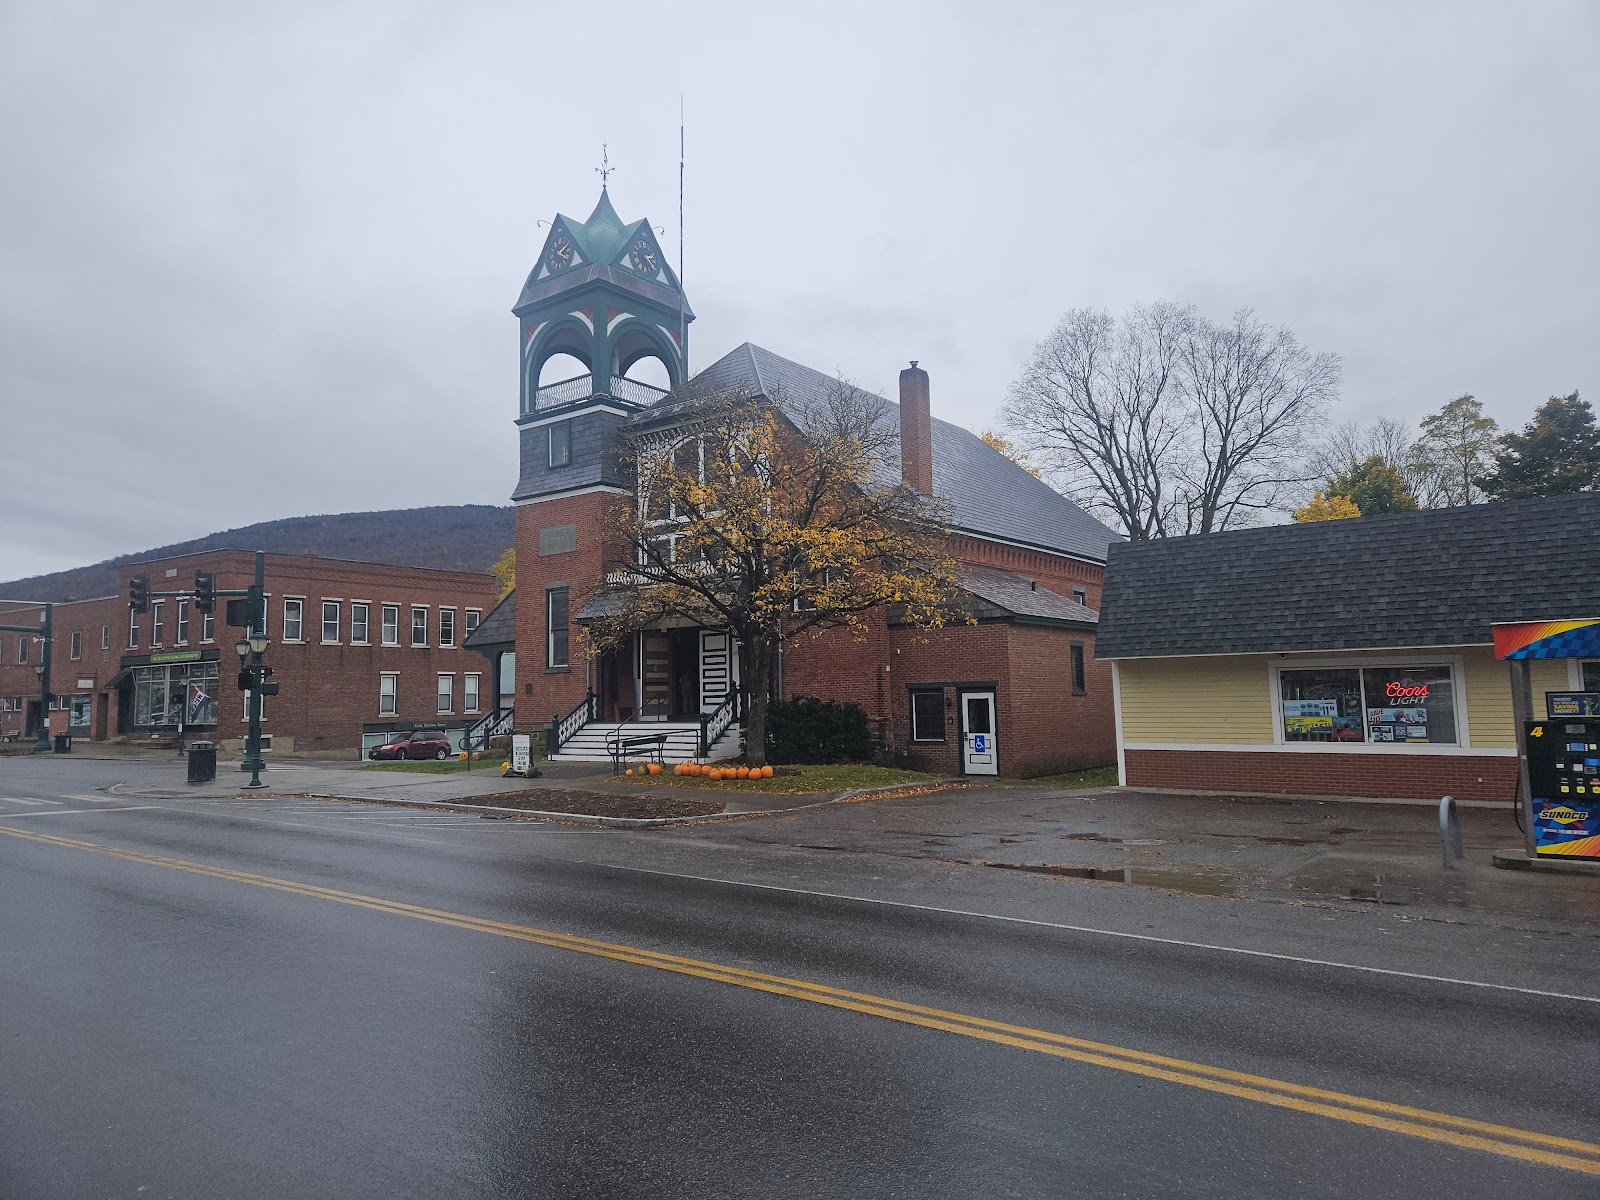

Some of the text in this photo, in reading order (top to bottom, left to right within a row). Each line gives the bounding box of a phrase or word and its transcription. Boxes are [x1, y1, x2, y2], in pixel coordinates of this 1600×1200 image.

[1386, 682, 1430, 697] Coors
[1390, 696, 1428, 705] LIGHT
[1370, 708, 1384, 716] SAVE
[1530, 726, 1544, 737] 4
[1541, 811, 1587, 819] SUNOCO
